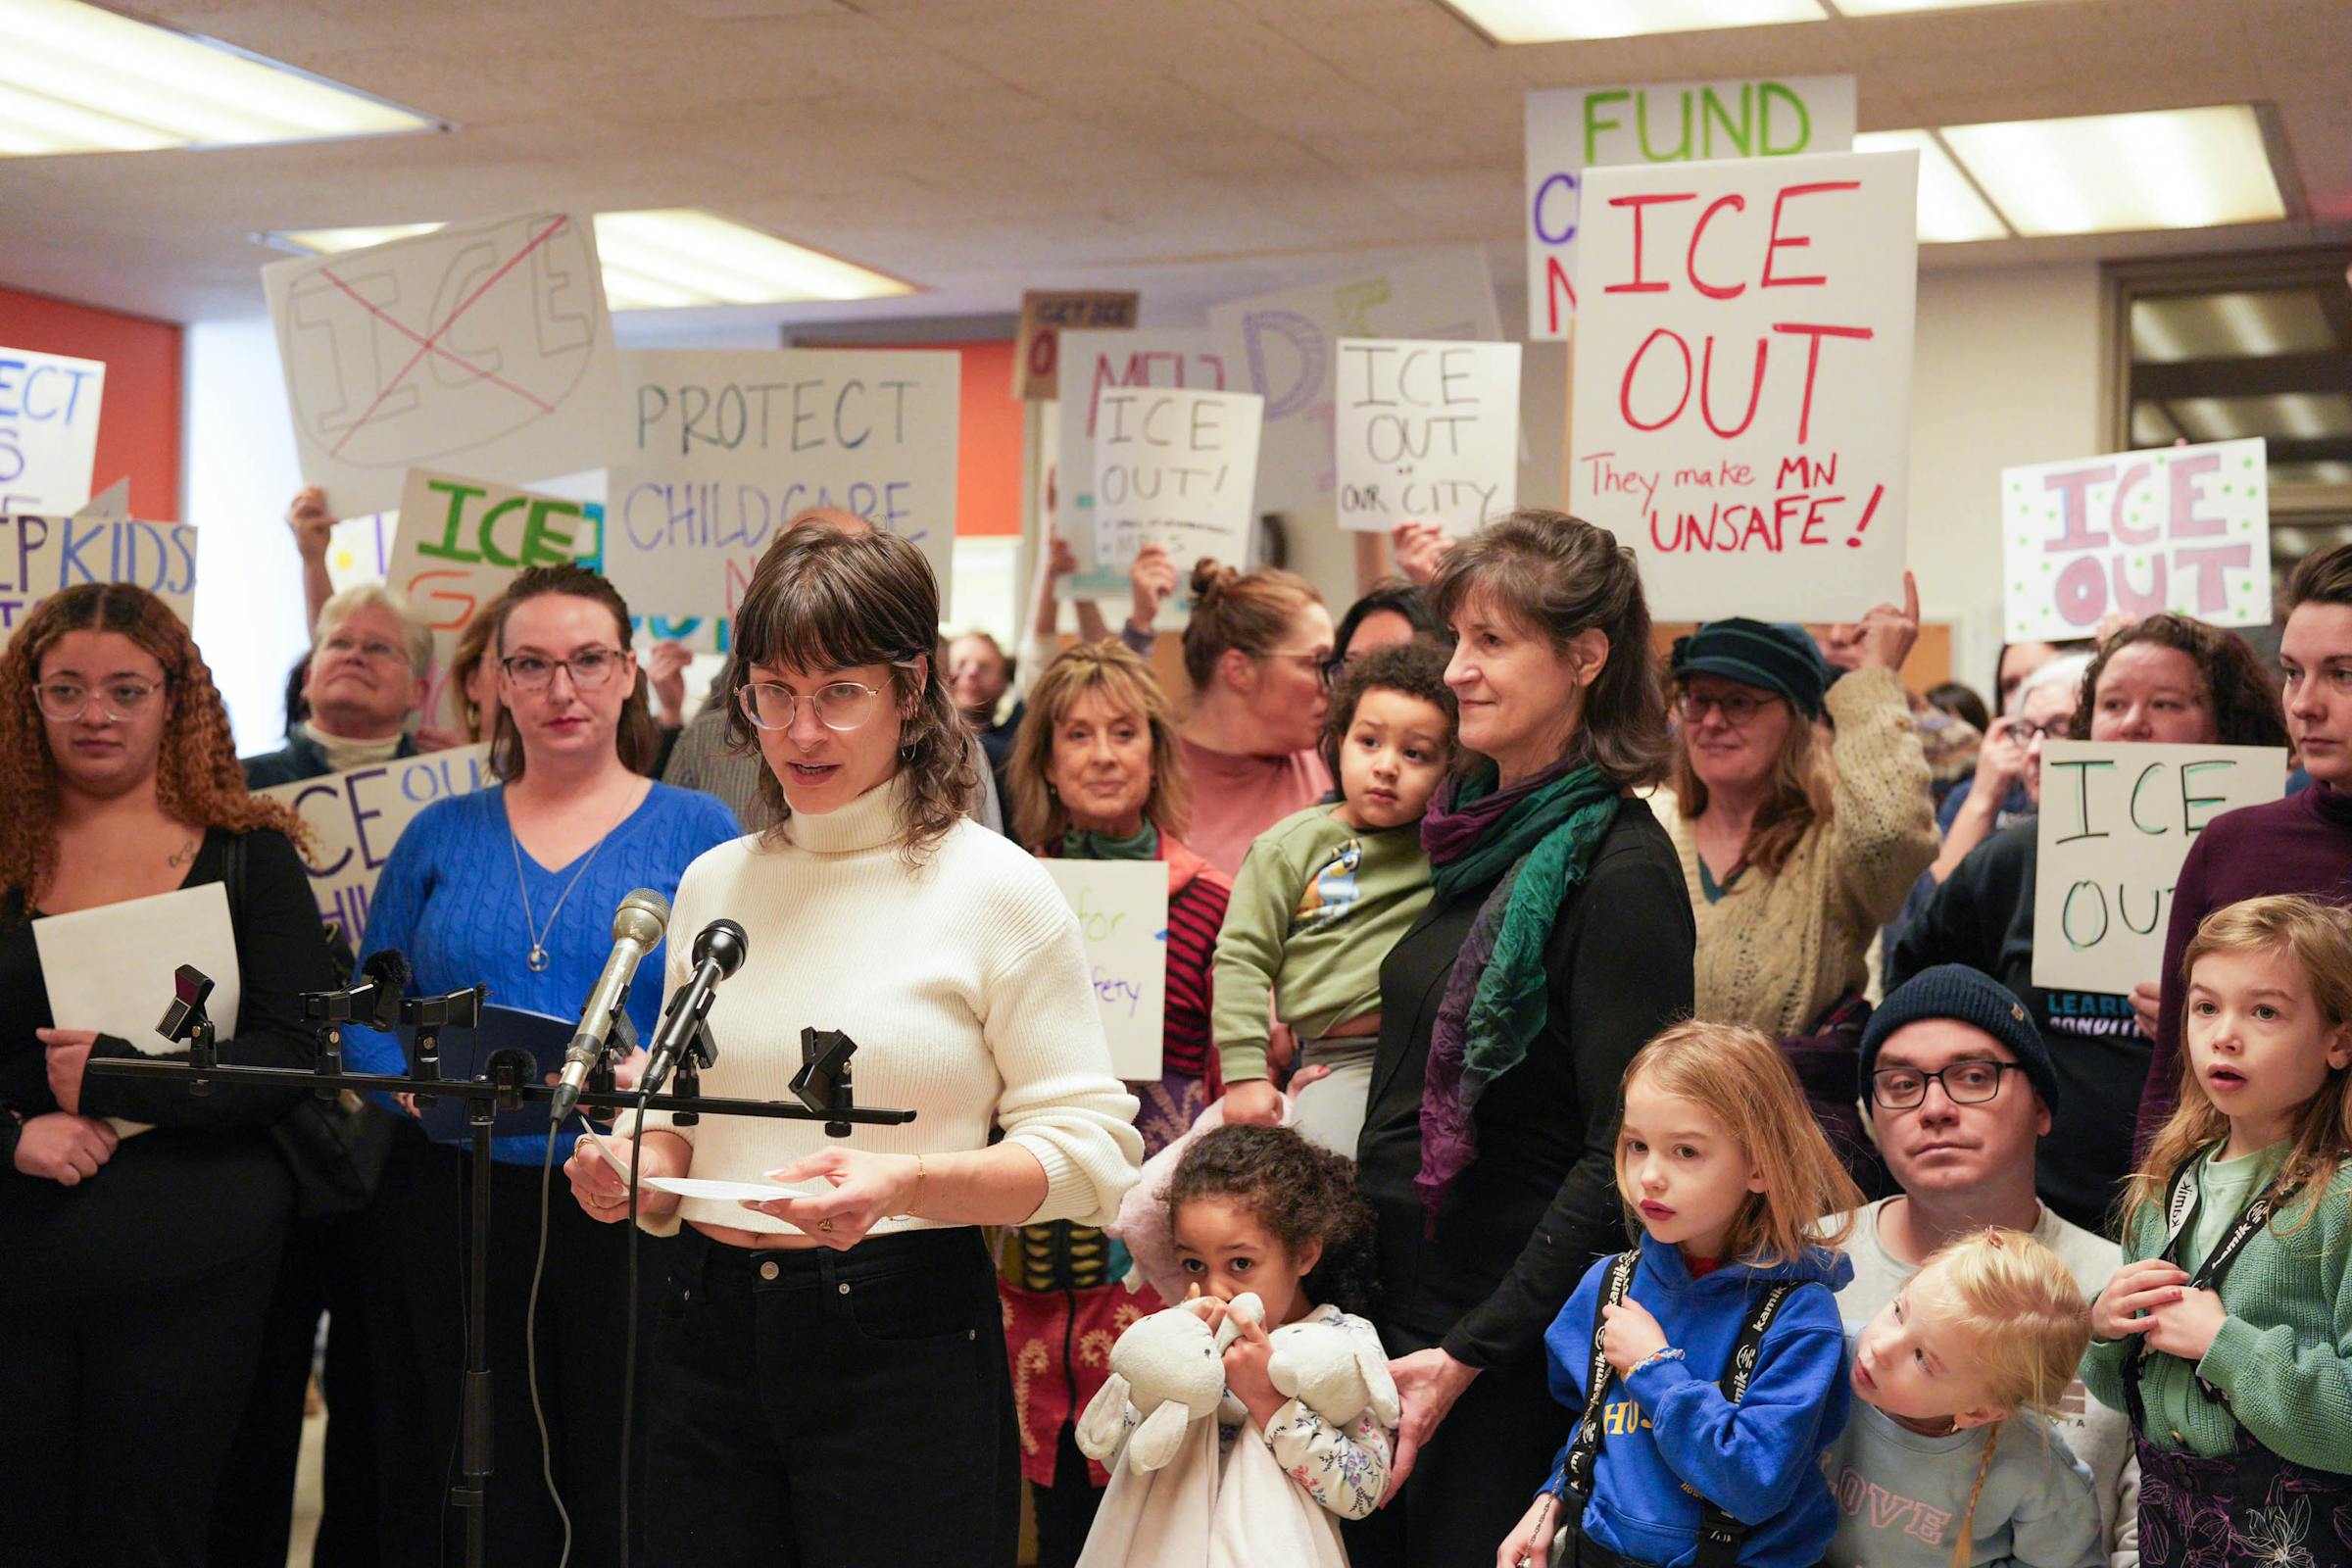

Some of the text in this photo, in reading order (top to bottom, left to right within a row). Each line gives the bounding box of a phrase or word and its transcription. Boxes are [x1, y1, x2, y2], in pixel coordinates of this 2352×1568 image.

[1583, 81, 1811, 164] FUND
[1603, 180, 1861, 301] ICE
[290, 214, 594, 434] ICE
[1344, 346, 1480, 408] ICE
[1620, 322, 1874, 445] OUT
[638, 379, 922, 455] PROTECT
[1103, 396, 1226, 451] ICE
[1366, 413, 1478, 465] OUT
[1101, 465, 1229, 509] OUT!
[1401, 478, 1498, 528] CITY
[1581, 451, 1838, 516] They make MN
[1650, 483, 1885, 553] UNSAFE!
[2043, 453, 2228, 553] ICE
[59, 516, 198, 595] KIDS
[416, 479, 582, 567] ICE
[2054, 543, 2252, 627] OUT
[294, 757, 483, 879] CE OU
[2049, 760, 2238, 845] ICE
[2062, 879, 2178, 952] OU
[1752, 1285, 1788, 1333] kamik
